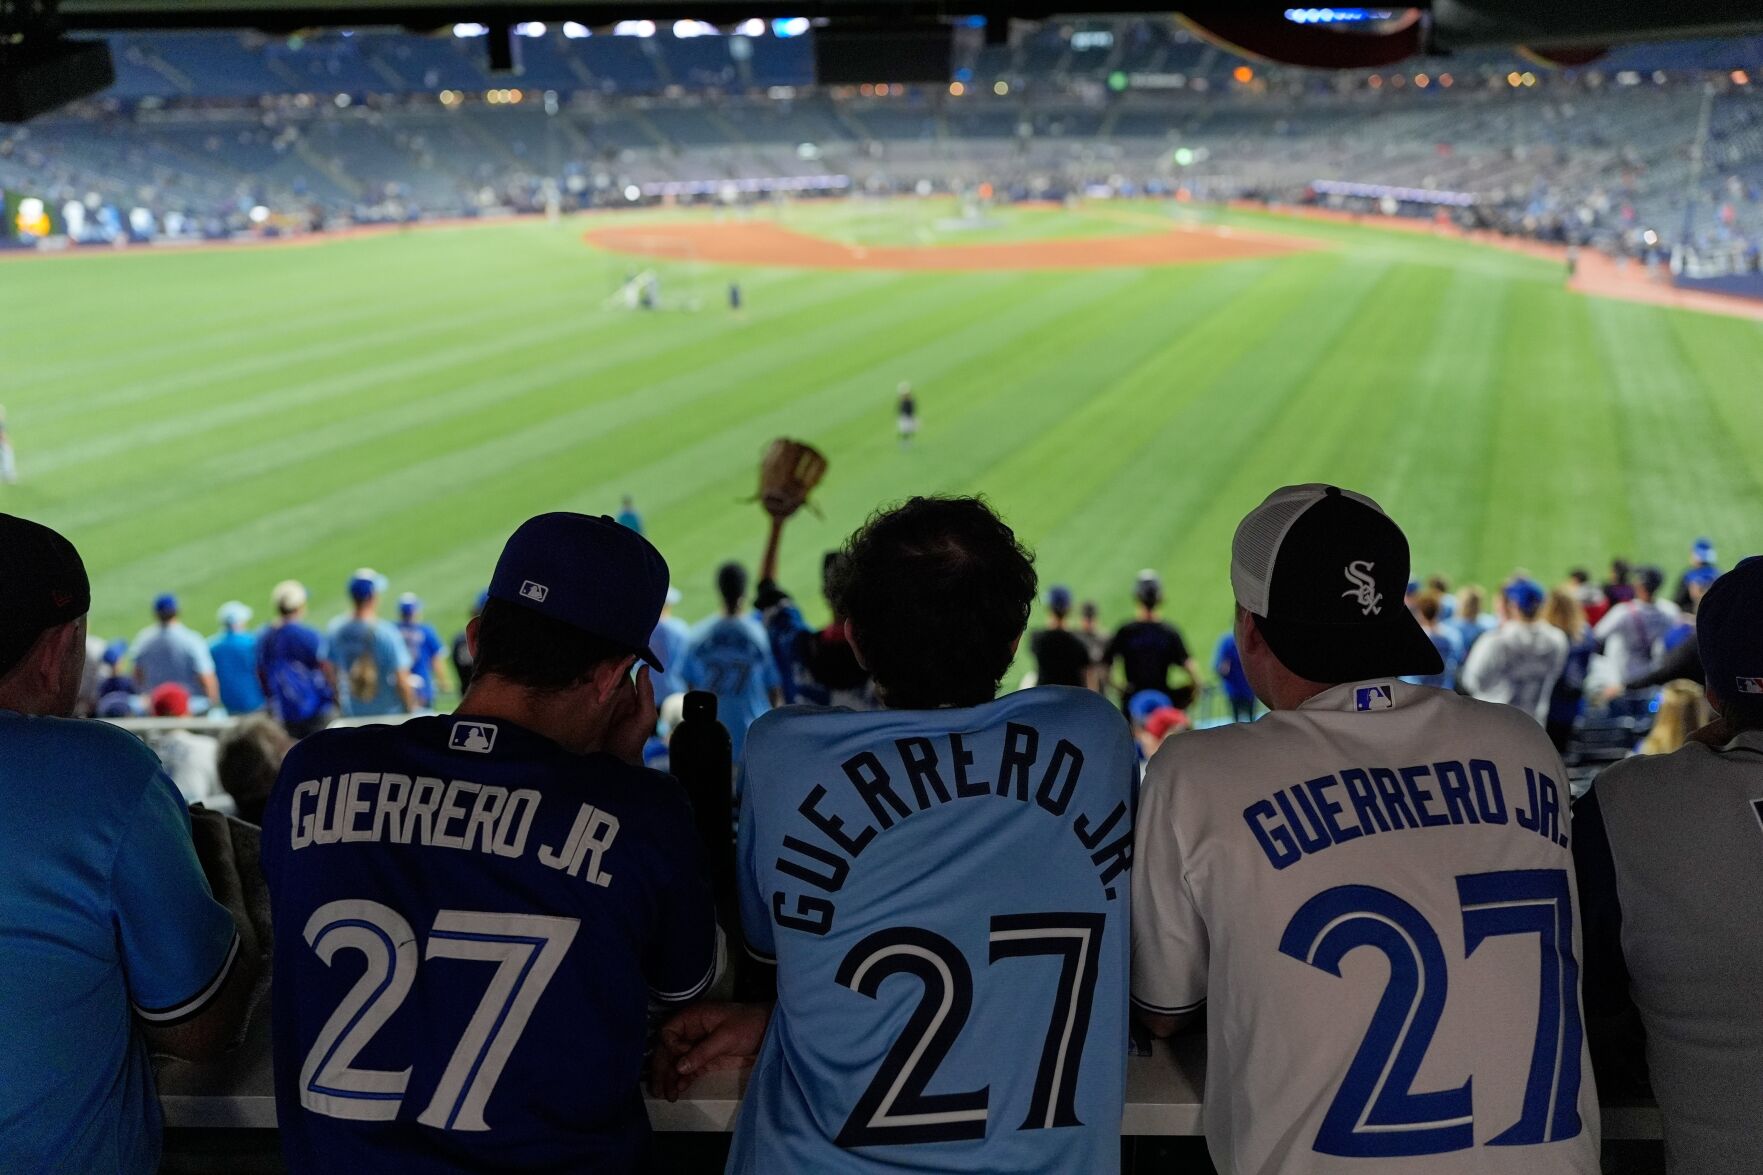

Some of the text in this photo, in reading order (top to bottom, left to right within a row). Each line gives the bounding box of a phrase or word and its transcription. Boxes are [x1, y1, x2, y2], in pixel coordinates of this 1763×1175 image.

[291, 772, 620, 888] GUERRERO JR.
[772, 722, 1085, 936] GUERRERO
[1243, 758, 1569, 871] GUERRERO JR.
[299, 898, 582, 1132] 27
[832, 911, 1107, 1149] 27
[1278, 868, 1583, 1158] 27
